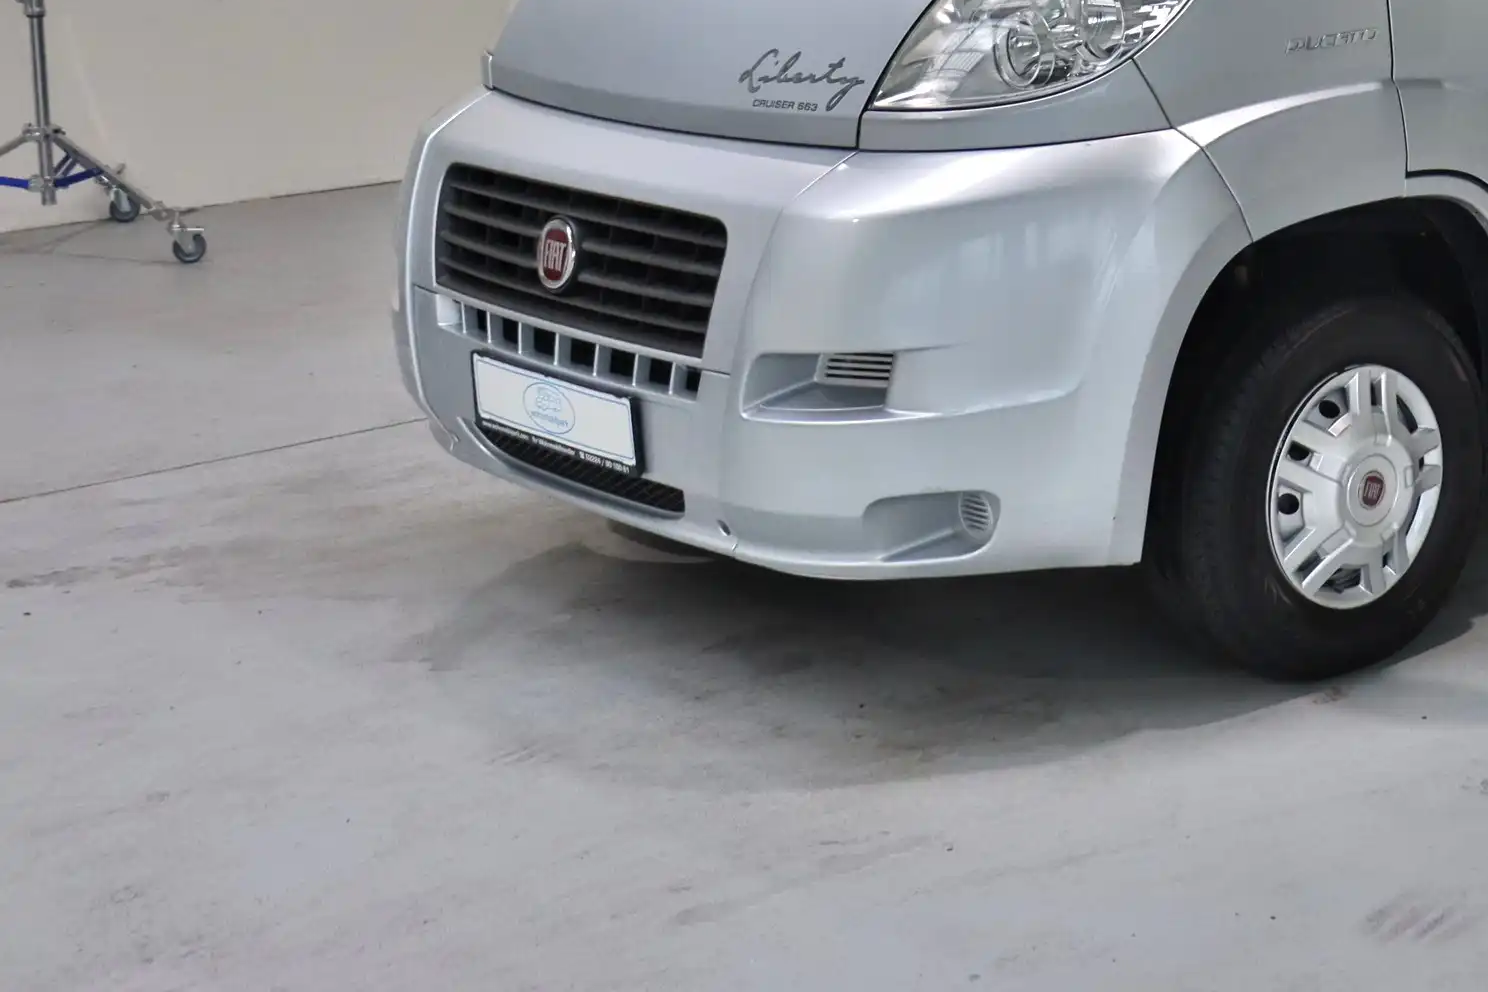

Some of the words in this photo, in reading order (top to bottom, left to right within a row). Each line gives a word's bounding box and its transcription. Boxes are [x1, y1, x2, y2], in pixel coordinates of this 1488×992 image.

[738, 48, 865, 111] Liberty
[752, 99, 795, 110] CRUISER
[797, 102, 818, 112] 663
[544, 239, 567, 272] FIAT
[1364, 481, 1381, 500] FIAT
